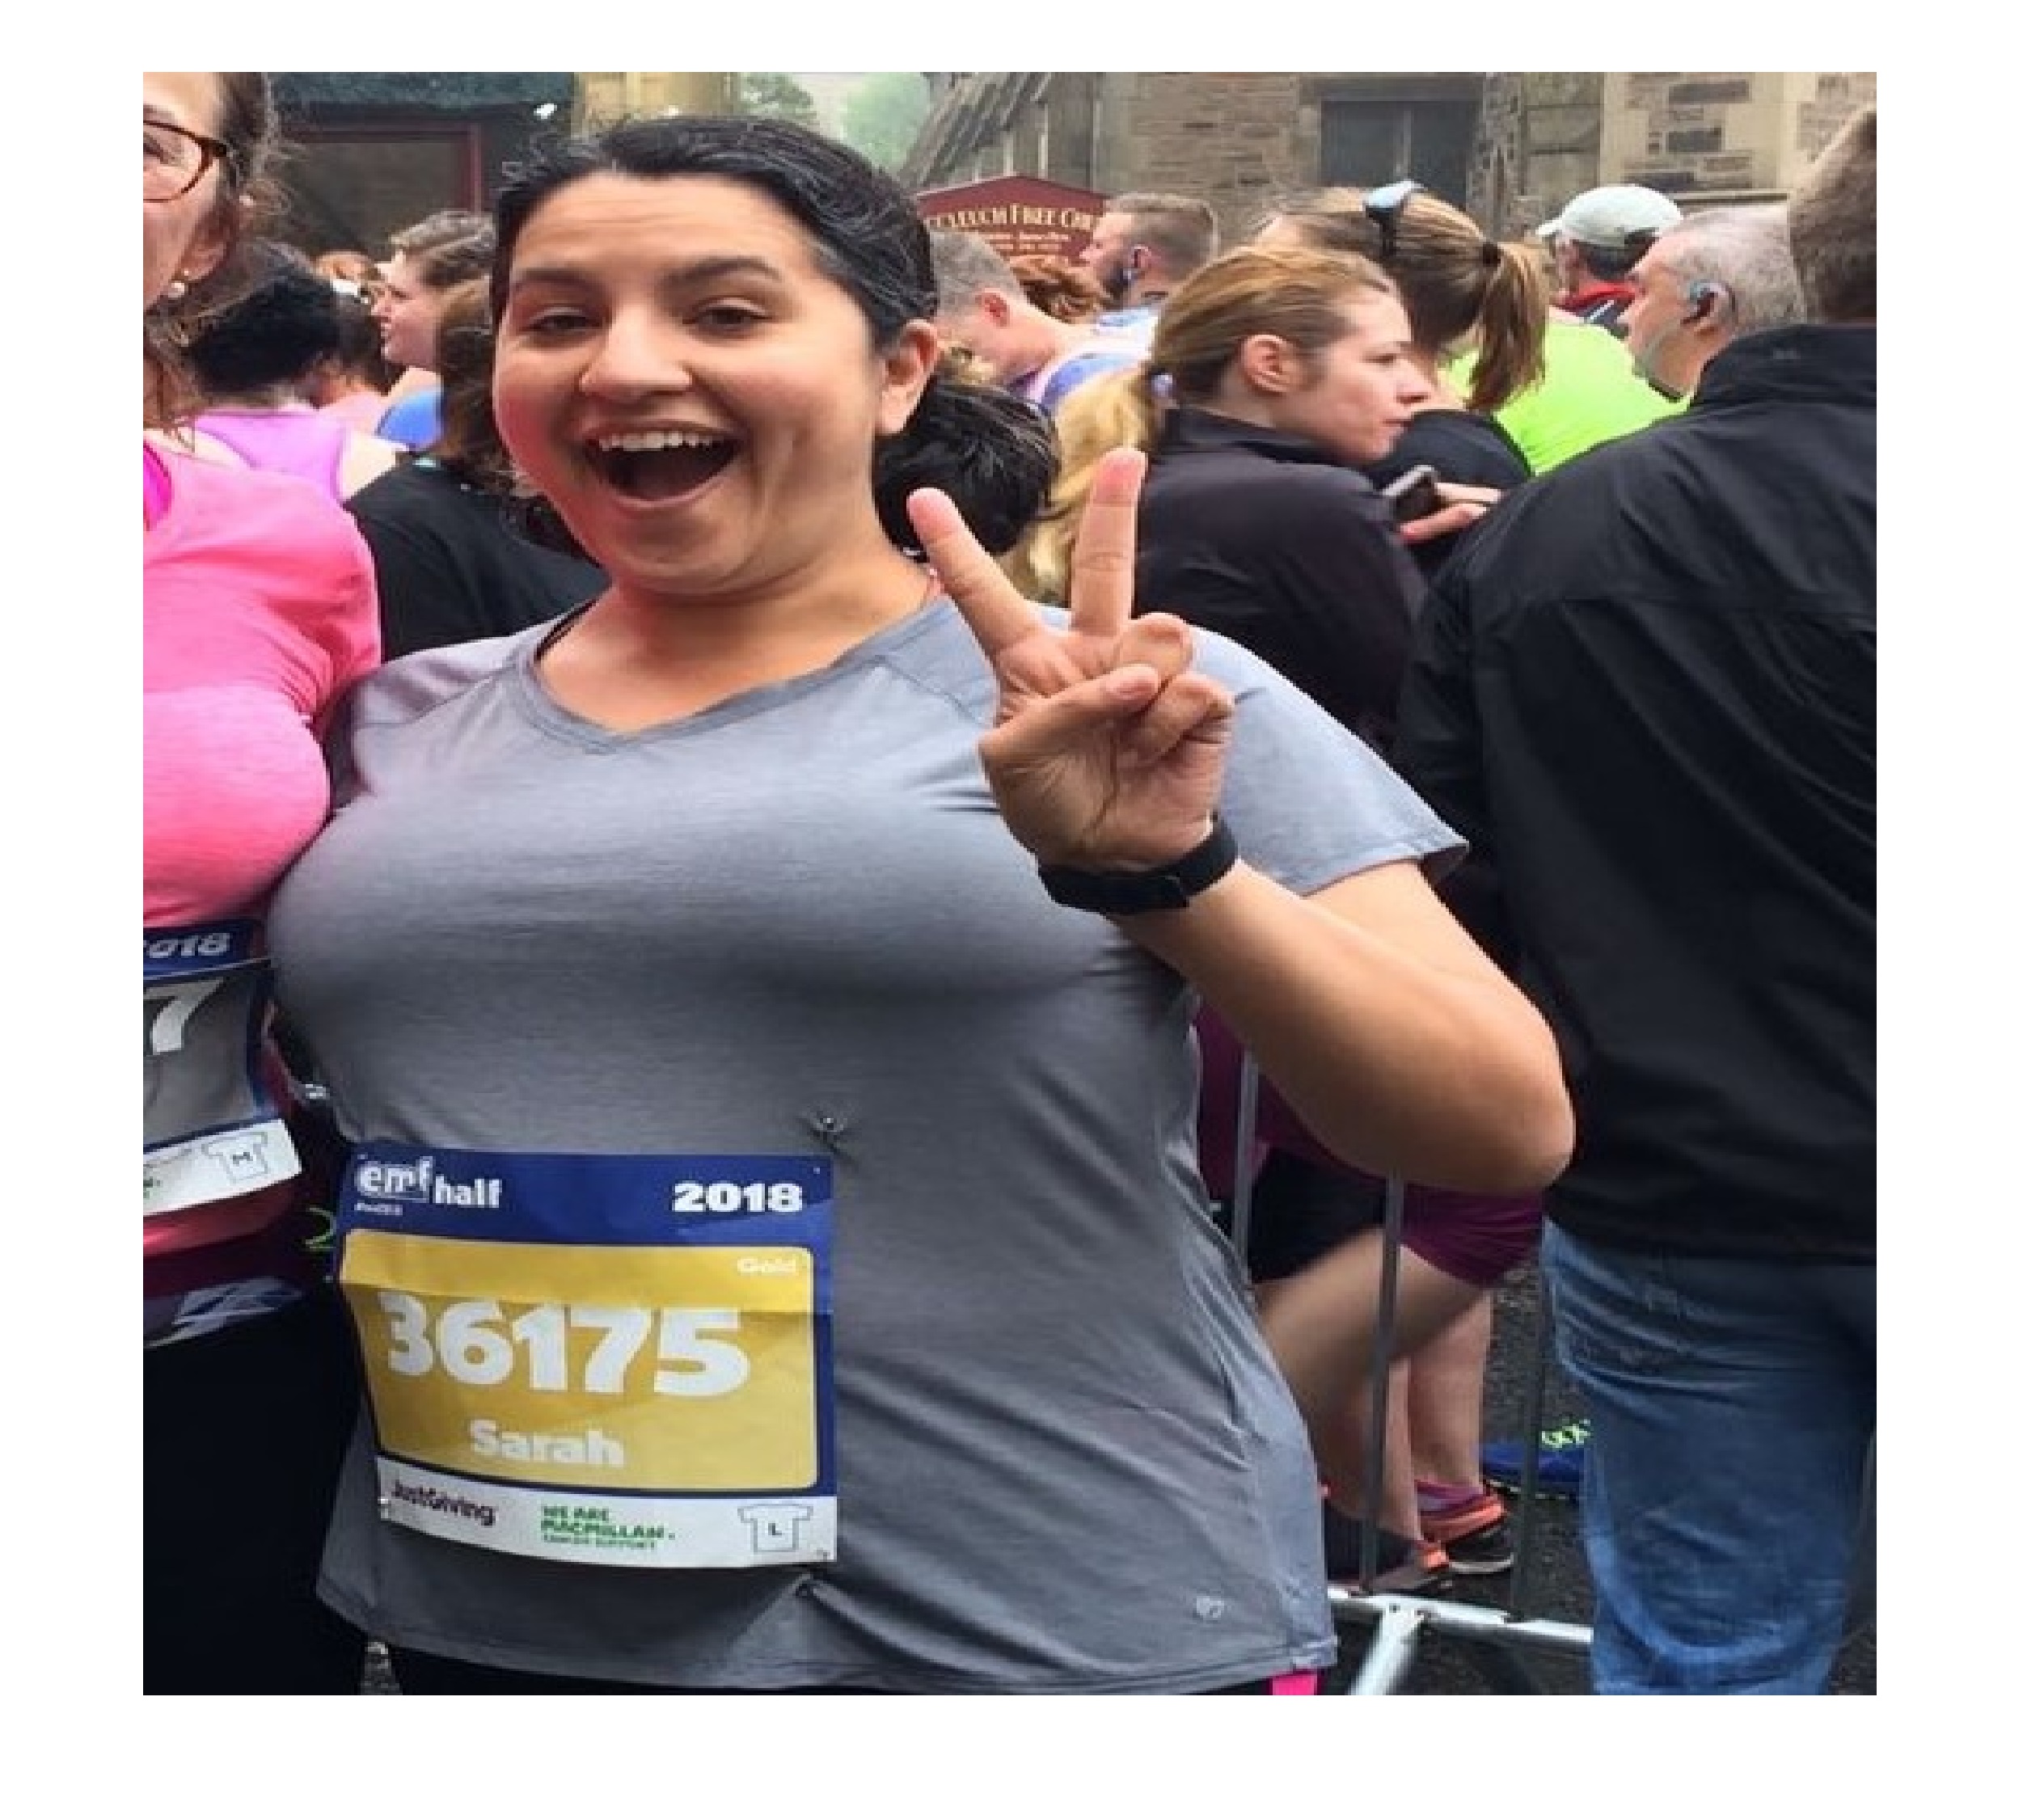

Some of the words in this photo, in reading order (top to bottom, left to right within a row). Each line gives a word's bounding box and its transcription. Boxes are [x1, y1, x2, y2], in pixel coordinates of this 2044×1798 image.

[143, 932, 231, 959] 018
[434, 1175, 502, 1209] half
[673, 1180, 803, 1212] 2018
[378, 1289, 750, 1397] 36175
[468, 1418, 625, 1467] Sarah
